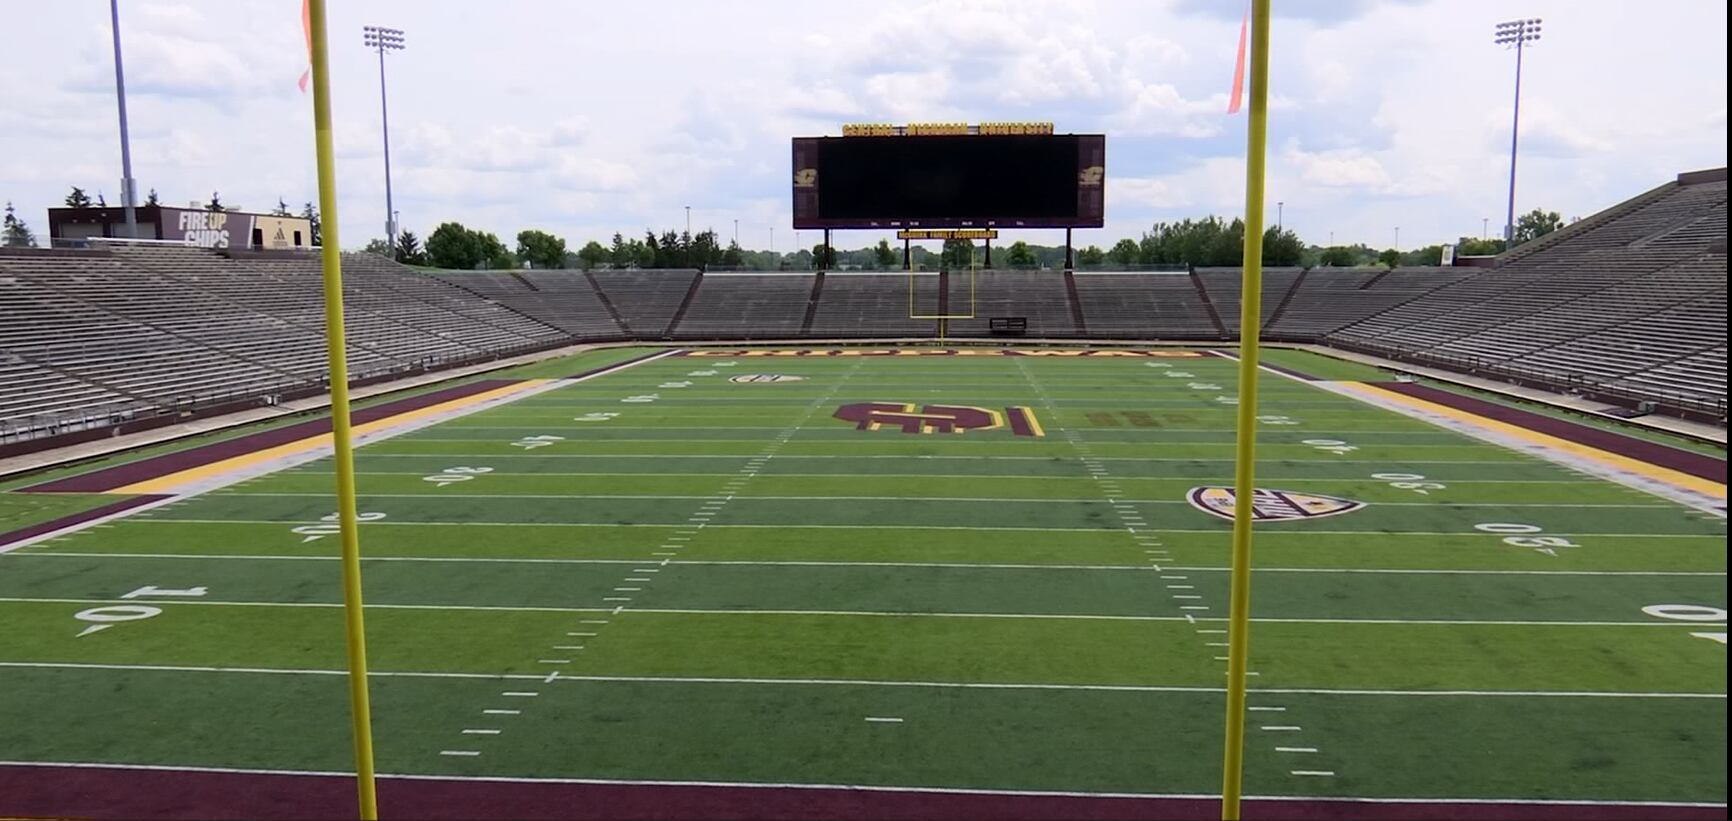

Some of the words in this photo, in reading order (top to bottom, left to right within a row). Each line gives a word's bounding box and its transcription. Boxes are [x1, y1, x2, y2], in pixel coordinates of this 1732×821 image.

[179, 211, 208, 230] FIRE
[208, 211, 227, 230] UP
[184, 229, 229, 248] CHIPS
[423, 466, 494, 482] 30
[1370, 472, 1446, 489] 30
[1474, 523, 1582, 547] 20
[73, 585, 208, 622] 10
